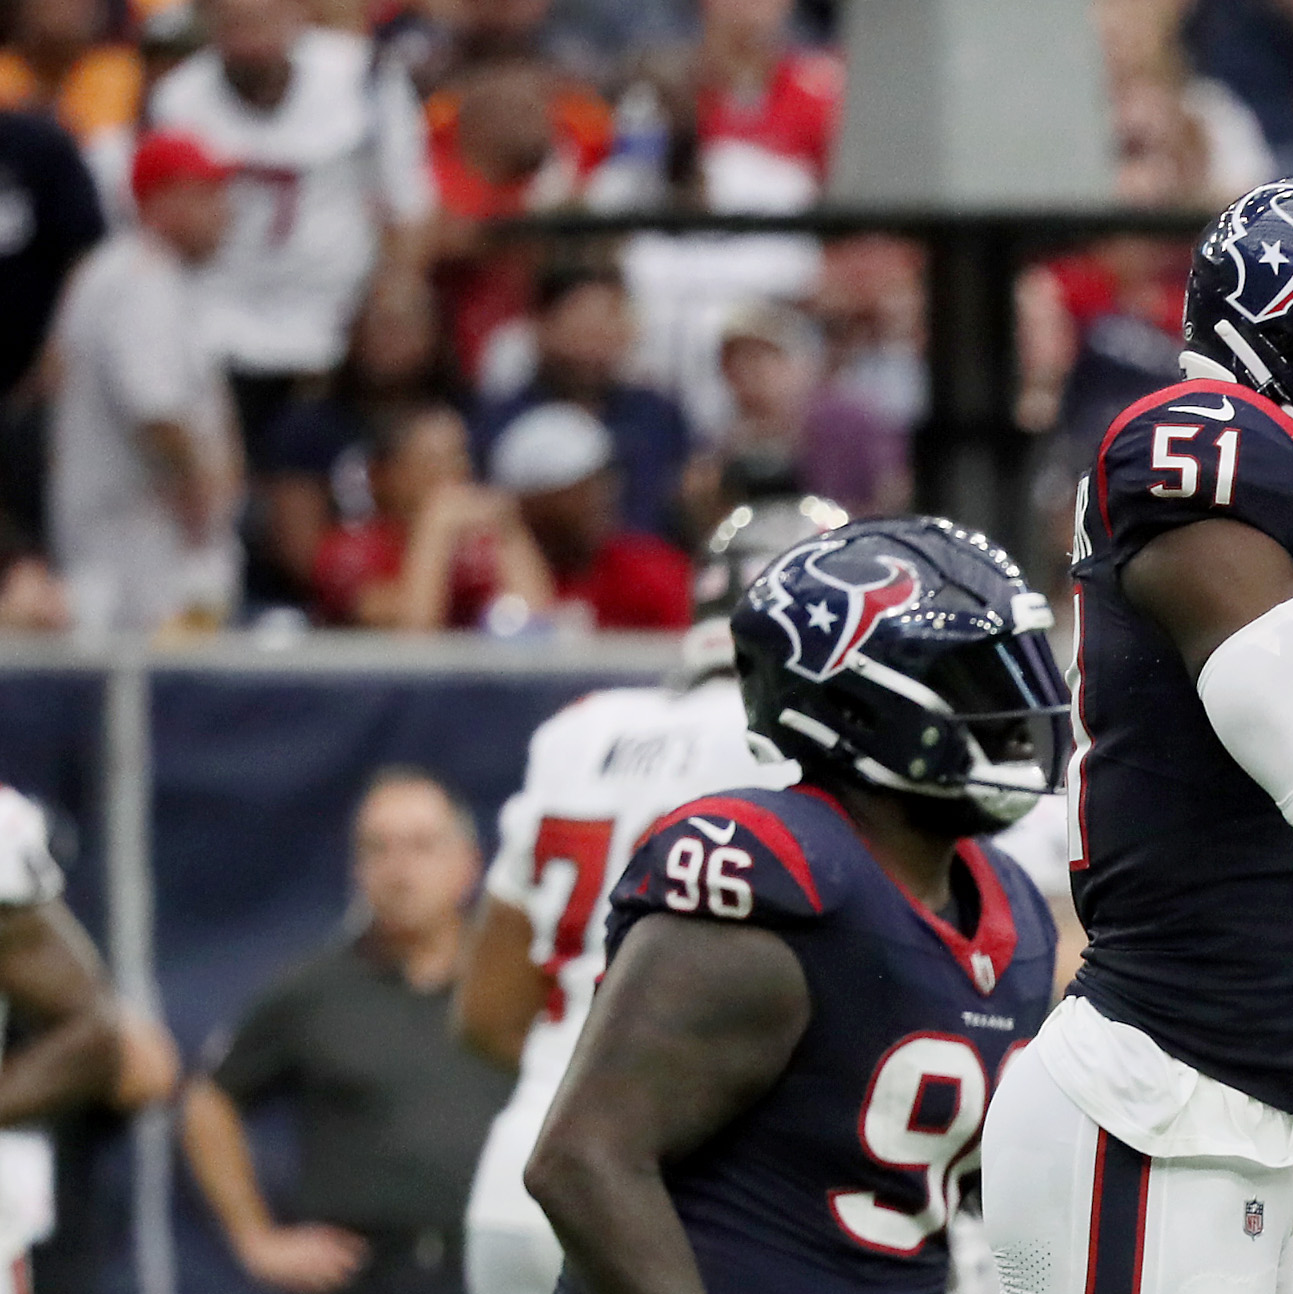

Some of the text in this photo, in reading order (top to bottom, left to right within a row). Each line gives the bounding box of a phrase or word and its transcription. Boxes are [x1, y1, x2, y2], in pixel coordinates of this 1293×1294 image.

[1146, 423, 1242, 507] 51
[664, 836, 754, 920] 96
[826, 1030, 1033, 1257] 9
